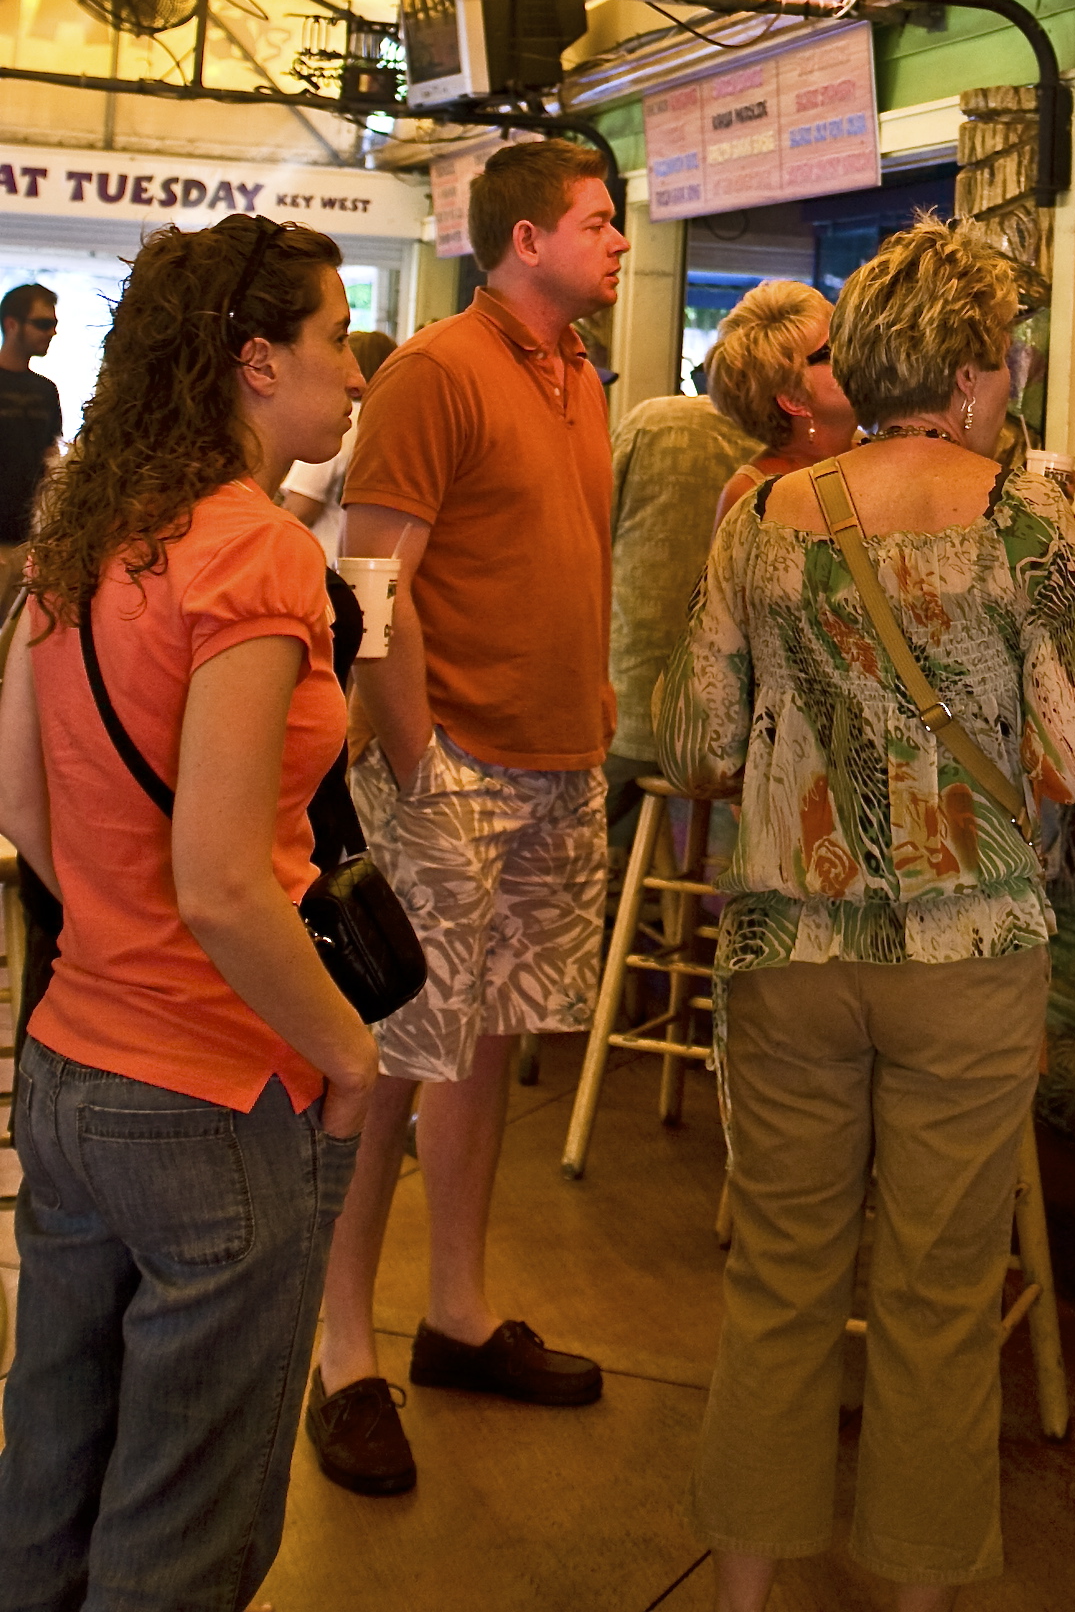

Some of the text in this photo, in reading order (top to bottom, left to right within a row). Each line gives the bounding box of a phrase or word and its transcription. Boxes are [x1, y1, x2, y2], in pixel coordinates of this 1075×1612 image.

[65, 170, 265, 212] TUESDAY
[275, 192, 315, 209] KEY
[320, 196, 373, 214] WEST
